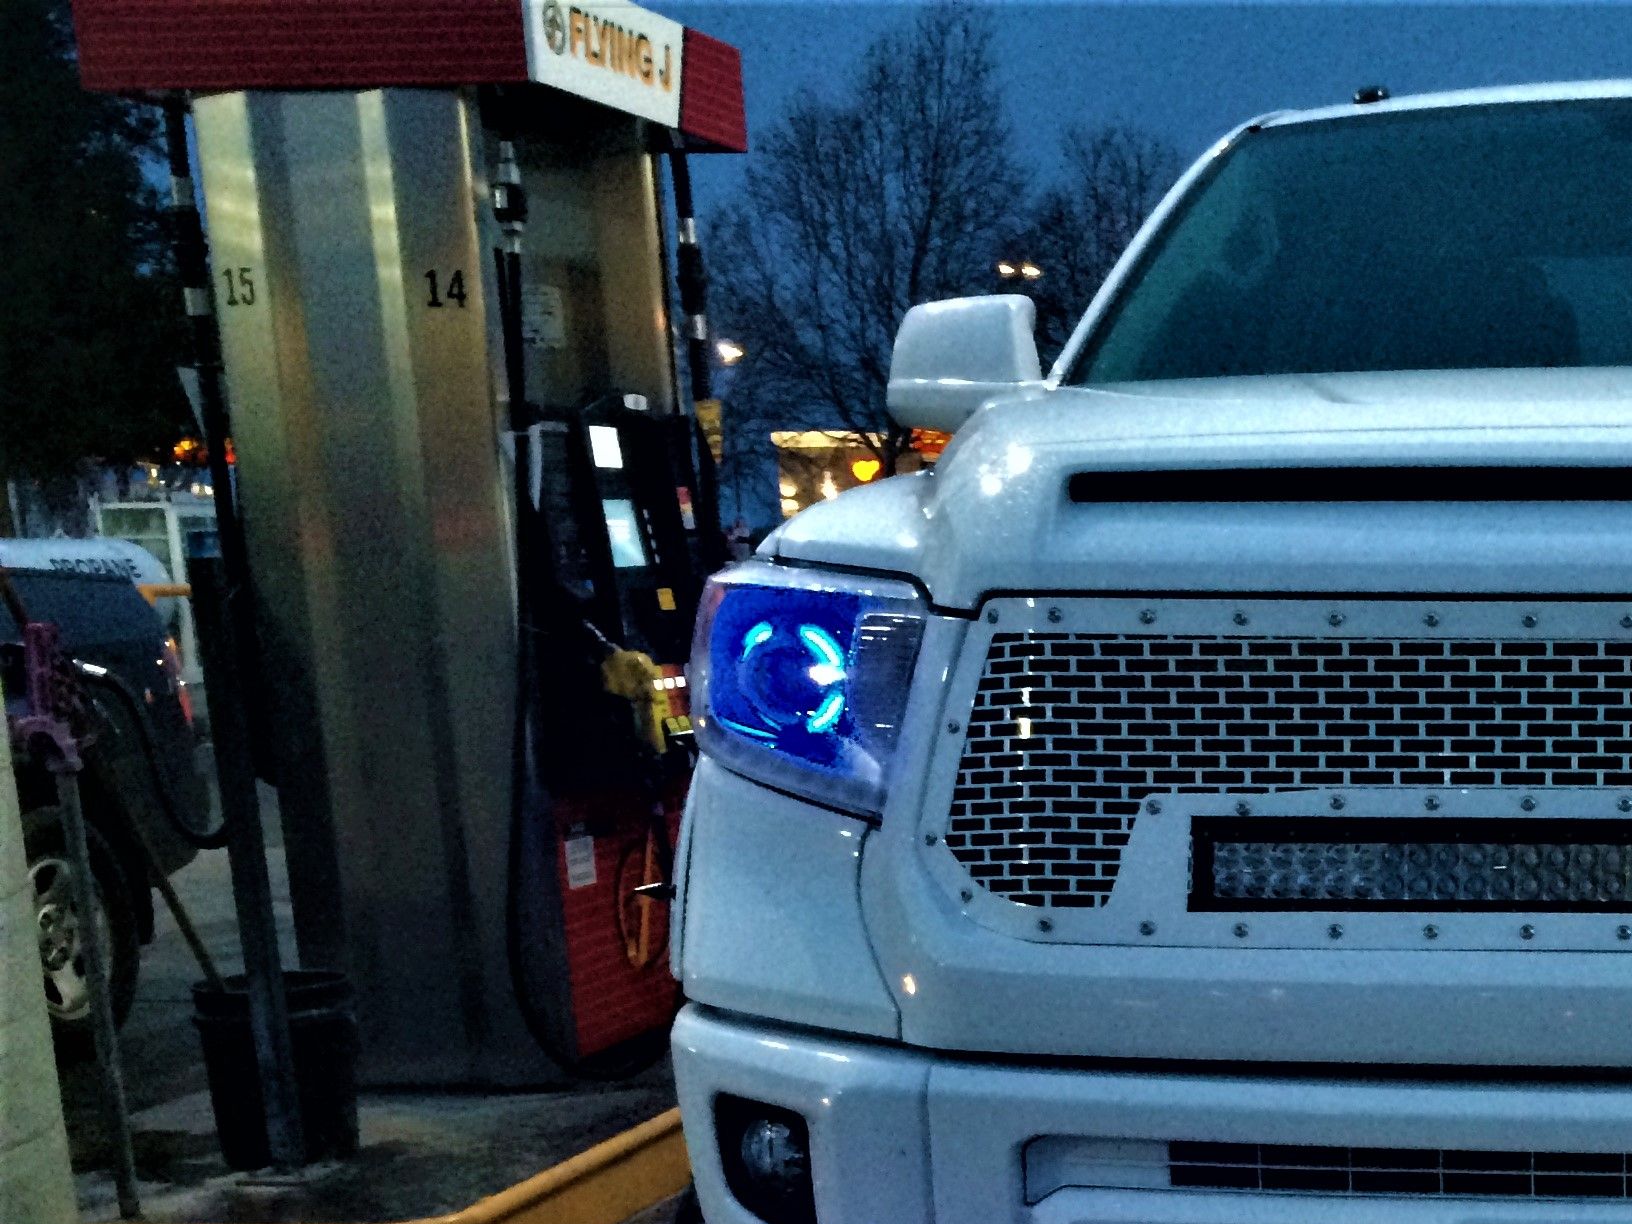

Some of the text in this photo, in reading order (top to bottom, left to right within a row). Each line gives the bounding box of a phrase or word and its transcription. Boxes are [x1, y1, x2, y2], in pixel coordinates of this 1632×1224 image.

[570, 6, 672, 93] FLYING J
[222, 267, 255, 306] 15
[425, 269, 466, 308] 14
